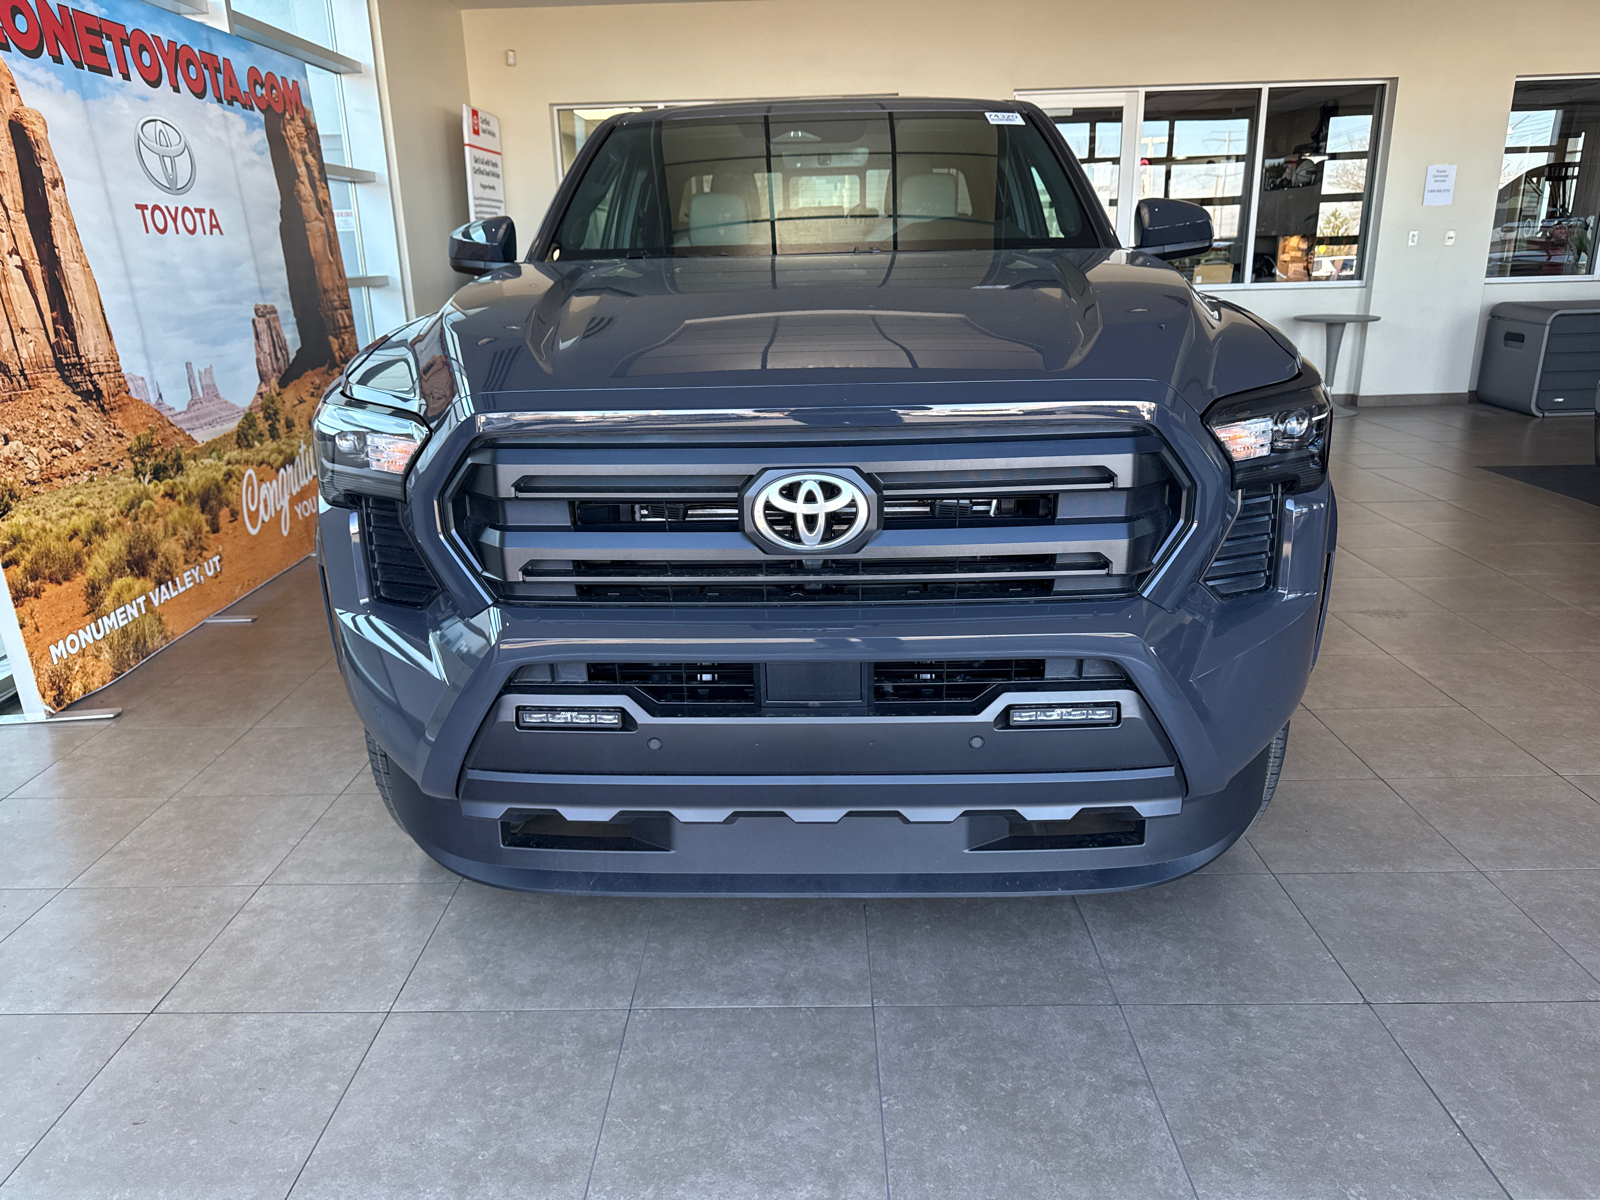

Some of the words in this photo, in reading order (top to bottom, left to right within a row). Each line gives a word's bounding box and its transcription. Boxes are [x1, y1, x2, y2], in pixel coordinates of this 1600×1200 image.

[0, 0, 306, 121] ONETOYOTA.COM
[134, 203, 224, 236] TOYOTA
[242, 439, 317, 537] Congratu
[294, 496, 317, 520] YOU
[49, 595, 147, 665] MONUMENT
[148, 565, 205, 607] VALLEY,
[204, 554, 221, 577] UT
